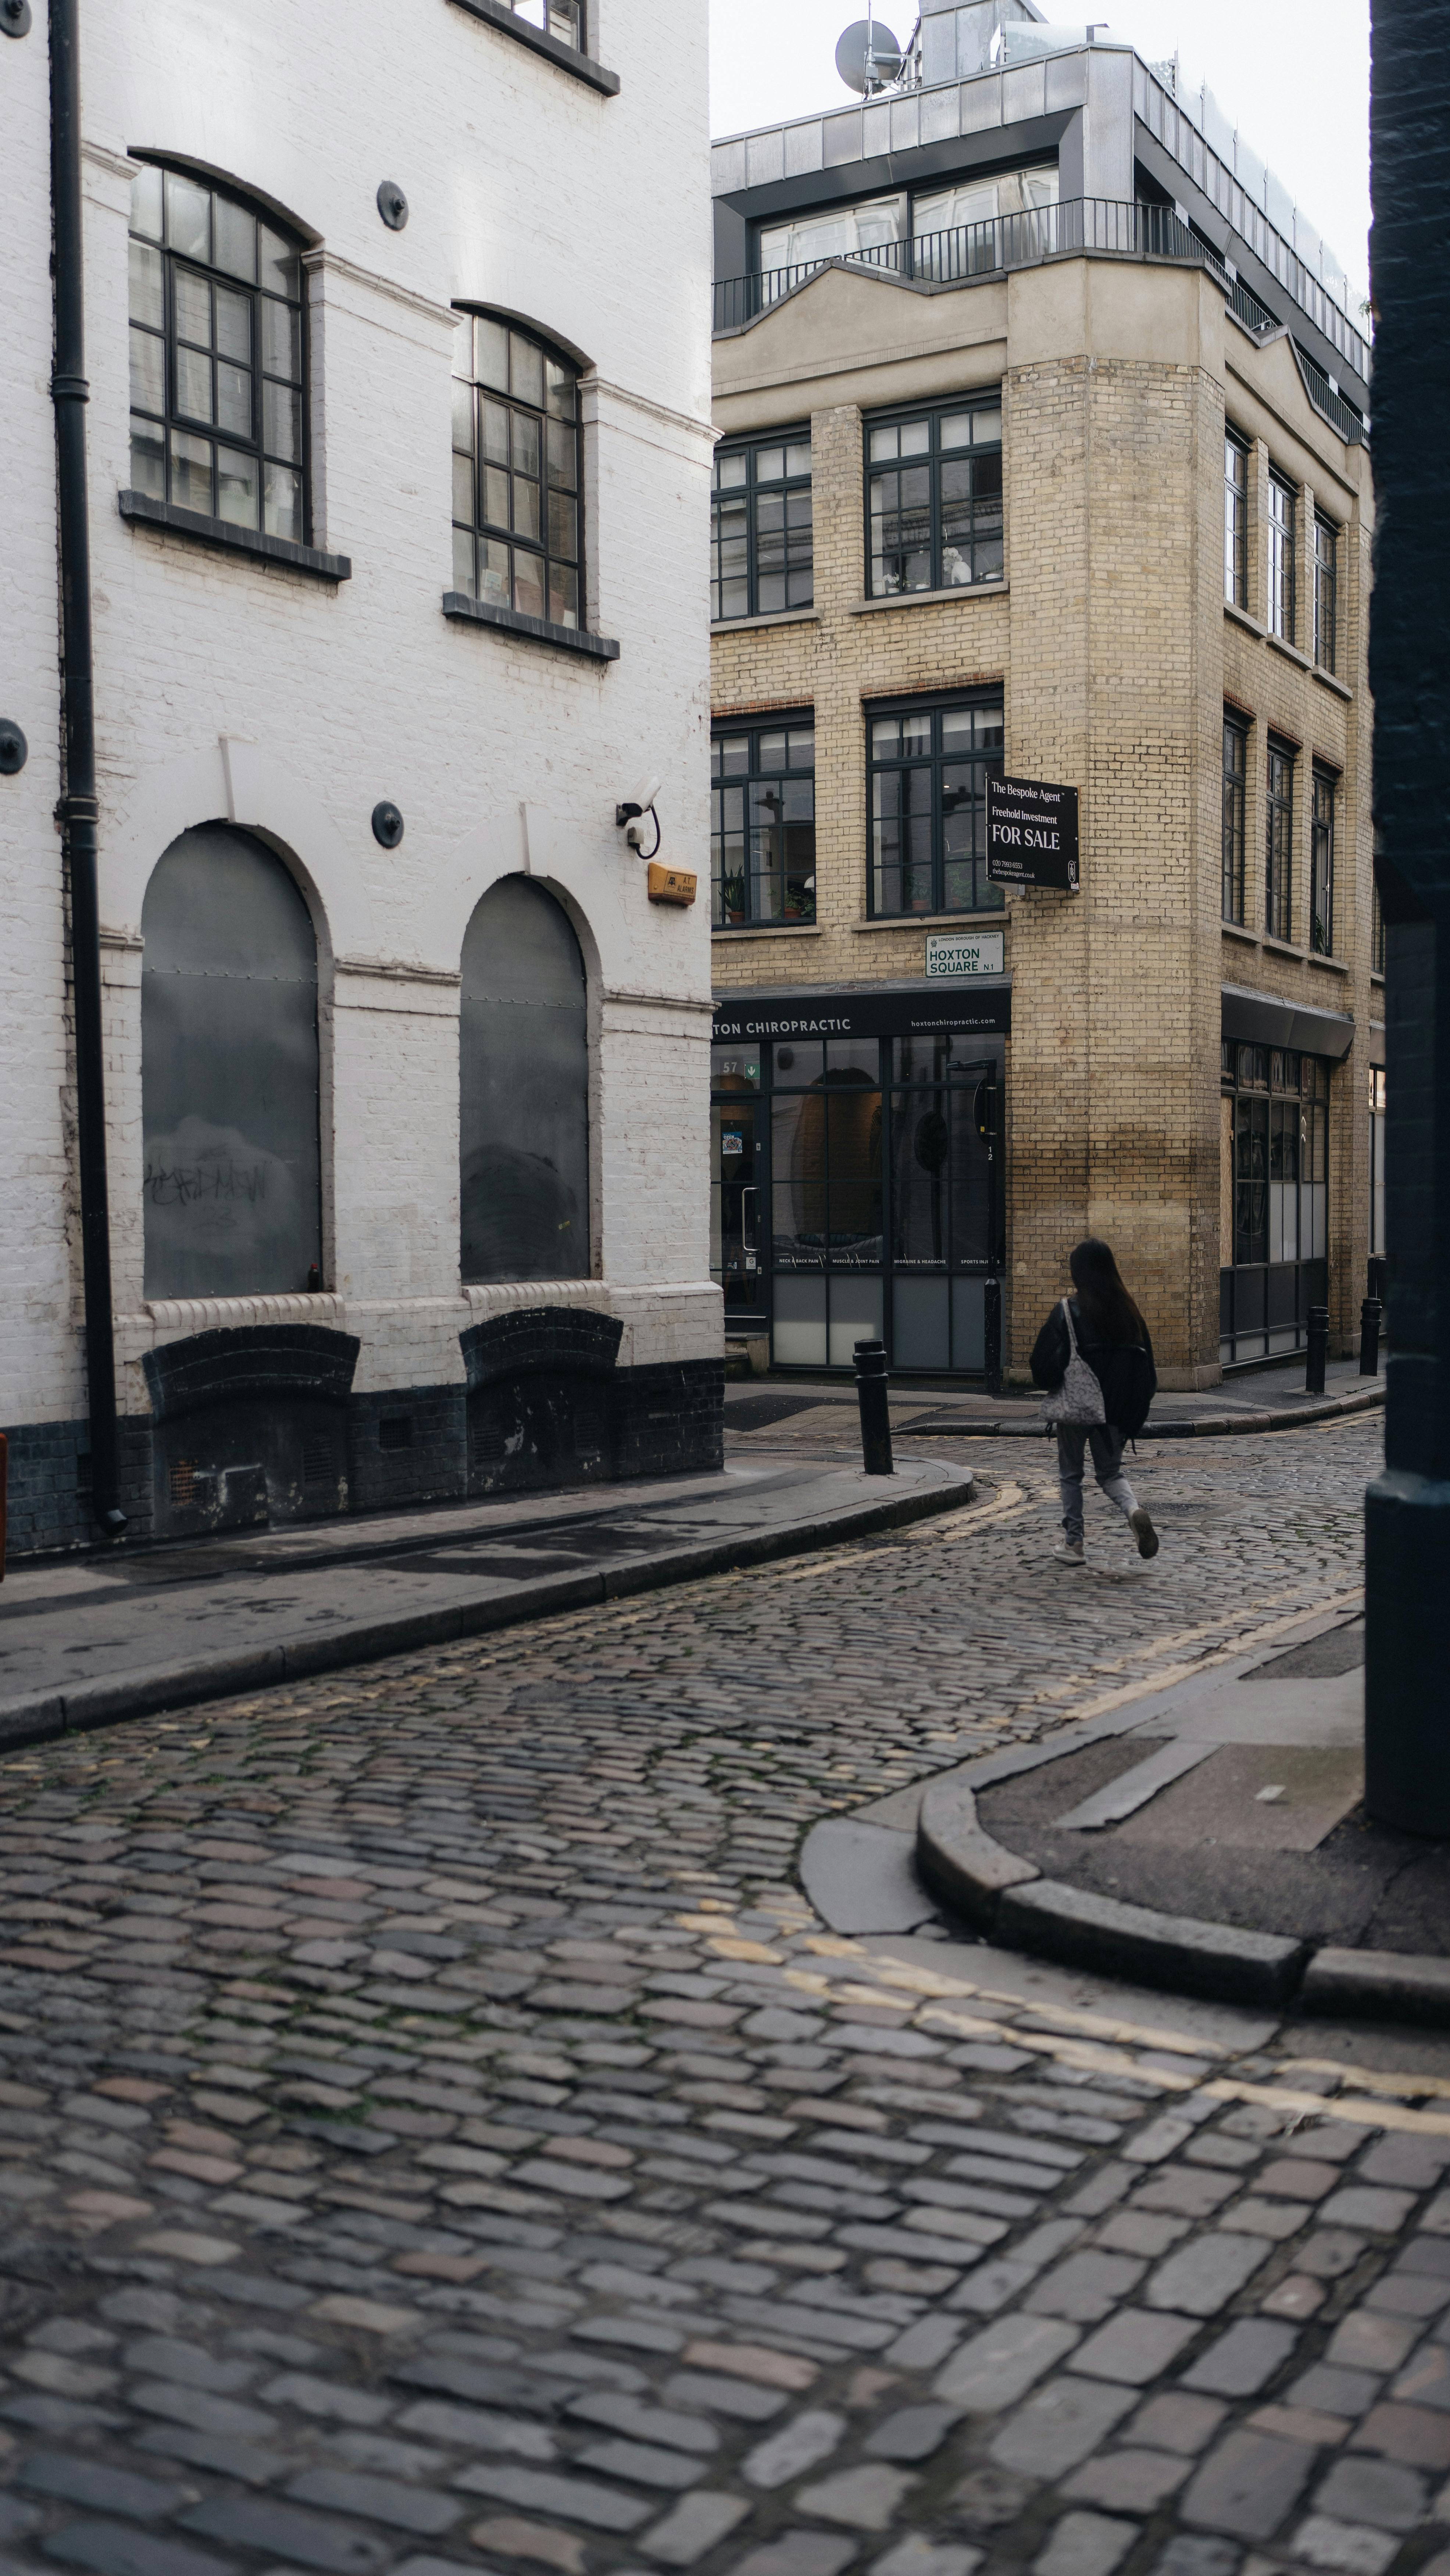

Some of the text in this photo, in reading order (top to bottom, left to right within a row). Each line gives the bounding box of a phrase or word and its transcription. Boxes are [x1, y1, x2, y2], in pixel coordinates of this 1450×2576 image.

[992, 781, 1006, 794] The
[1007, 784, 1038, 799] Bespoke
[1039, 789, 1061, 802] Agent
[992, 806, 1057, 824] Freehold Investment
[993, 824, 1060, 850] FOR SALE
[993, 868, 1035, 878] thebespokeagent.co.uk
[677, 885, 694, 894] ALARMS
[930, 948, 979, 961] HOXTON
[930, 961, 978, 974] SQUARE
[746, 1019, 851, 1033] CHIROPRACTIC
[911, 1018, 996, 1027] hoxtonchiropractic.com
[723, 1062, 737, 1073] 57
